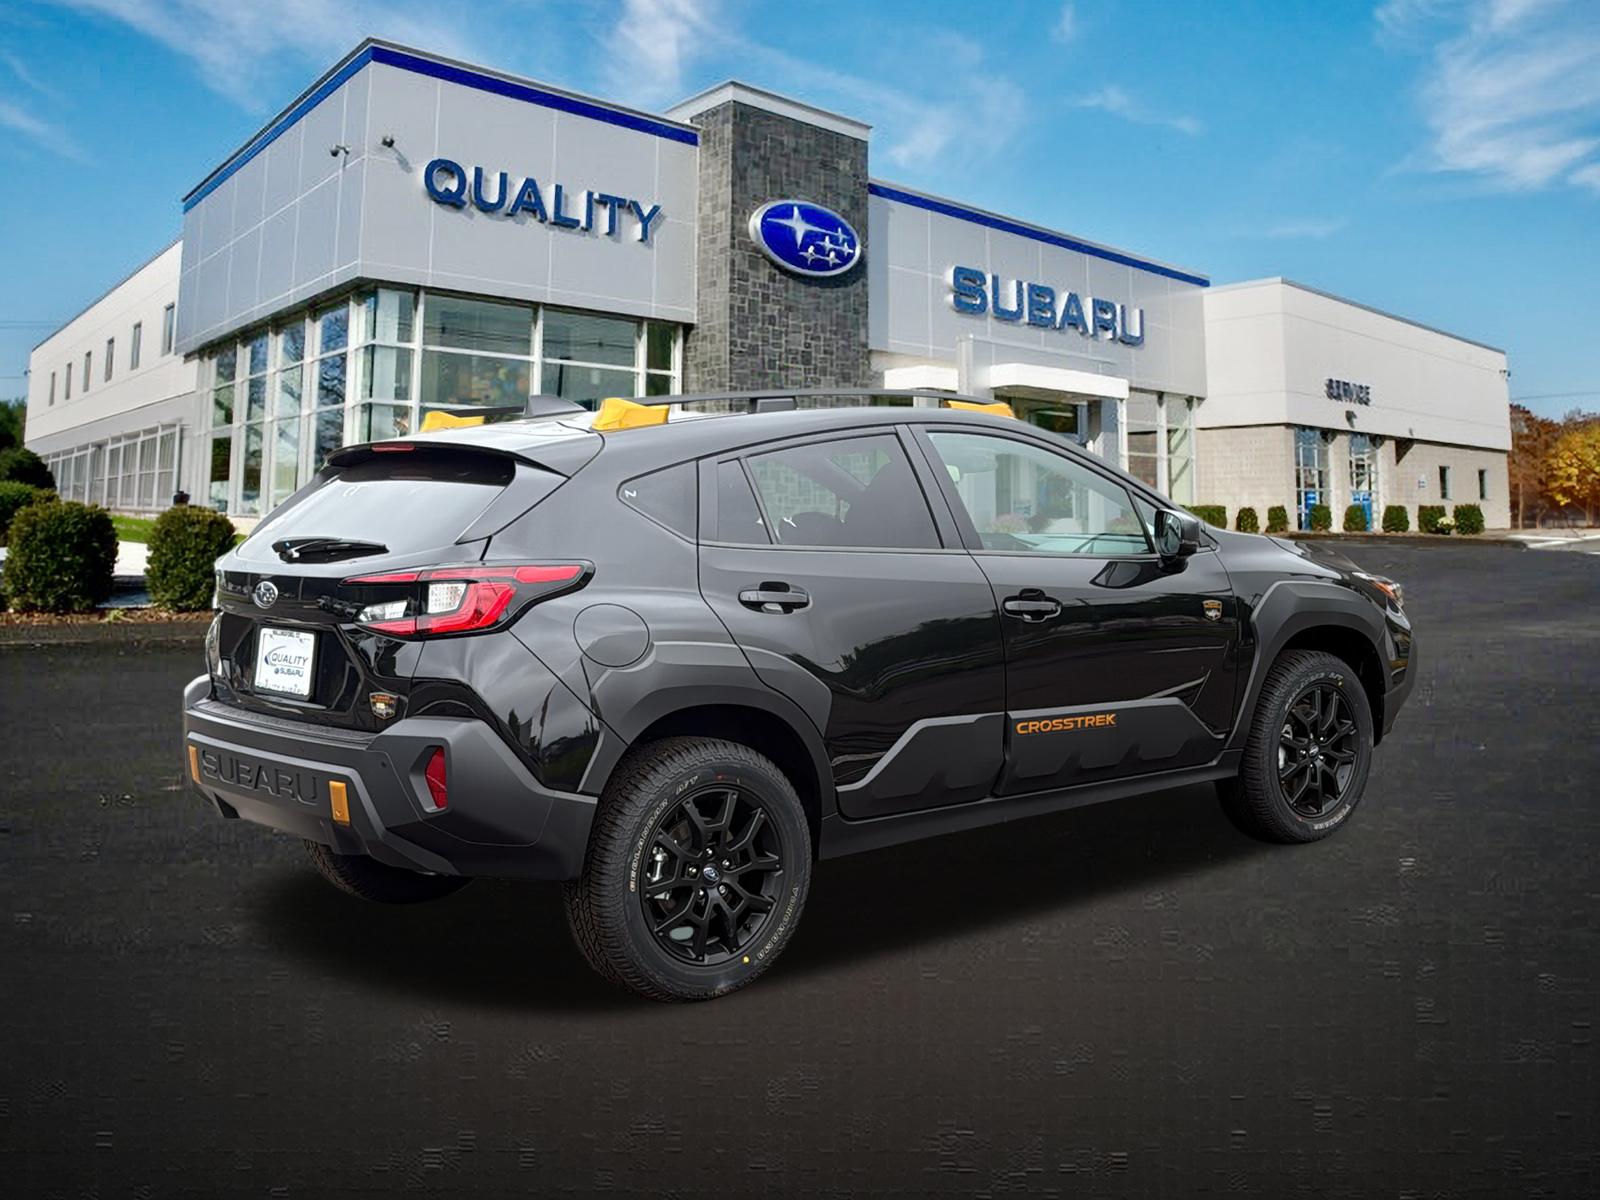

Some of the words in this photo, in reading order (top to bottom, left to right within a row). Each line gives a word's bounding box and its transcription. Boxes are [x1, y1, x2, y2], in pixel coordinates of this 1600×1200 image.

[424, 158, 662, 242] QUALITY
[949, 265, 1145, 346] SUBARU
[1325, 378, 1370, 406] SERVICE
[272, 652, 309, 666] QUALITY
[280, 667, 304, 677] SUBARU
[1016, 713, 1116, 734] CROSSTREK
[201, 750, 318, 806] SUBARU
